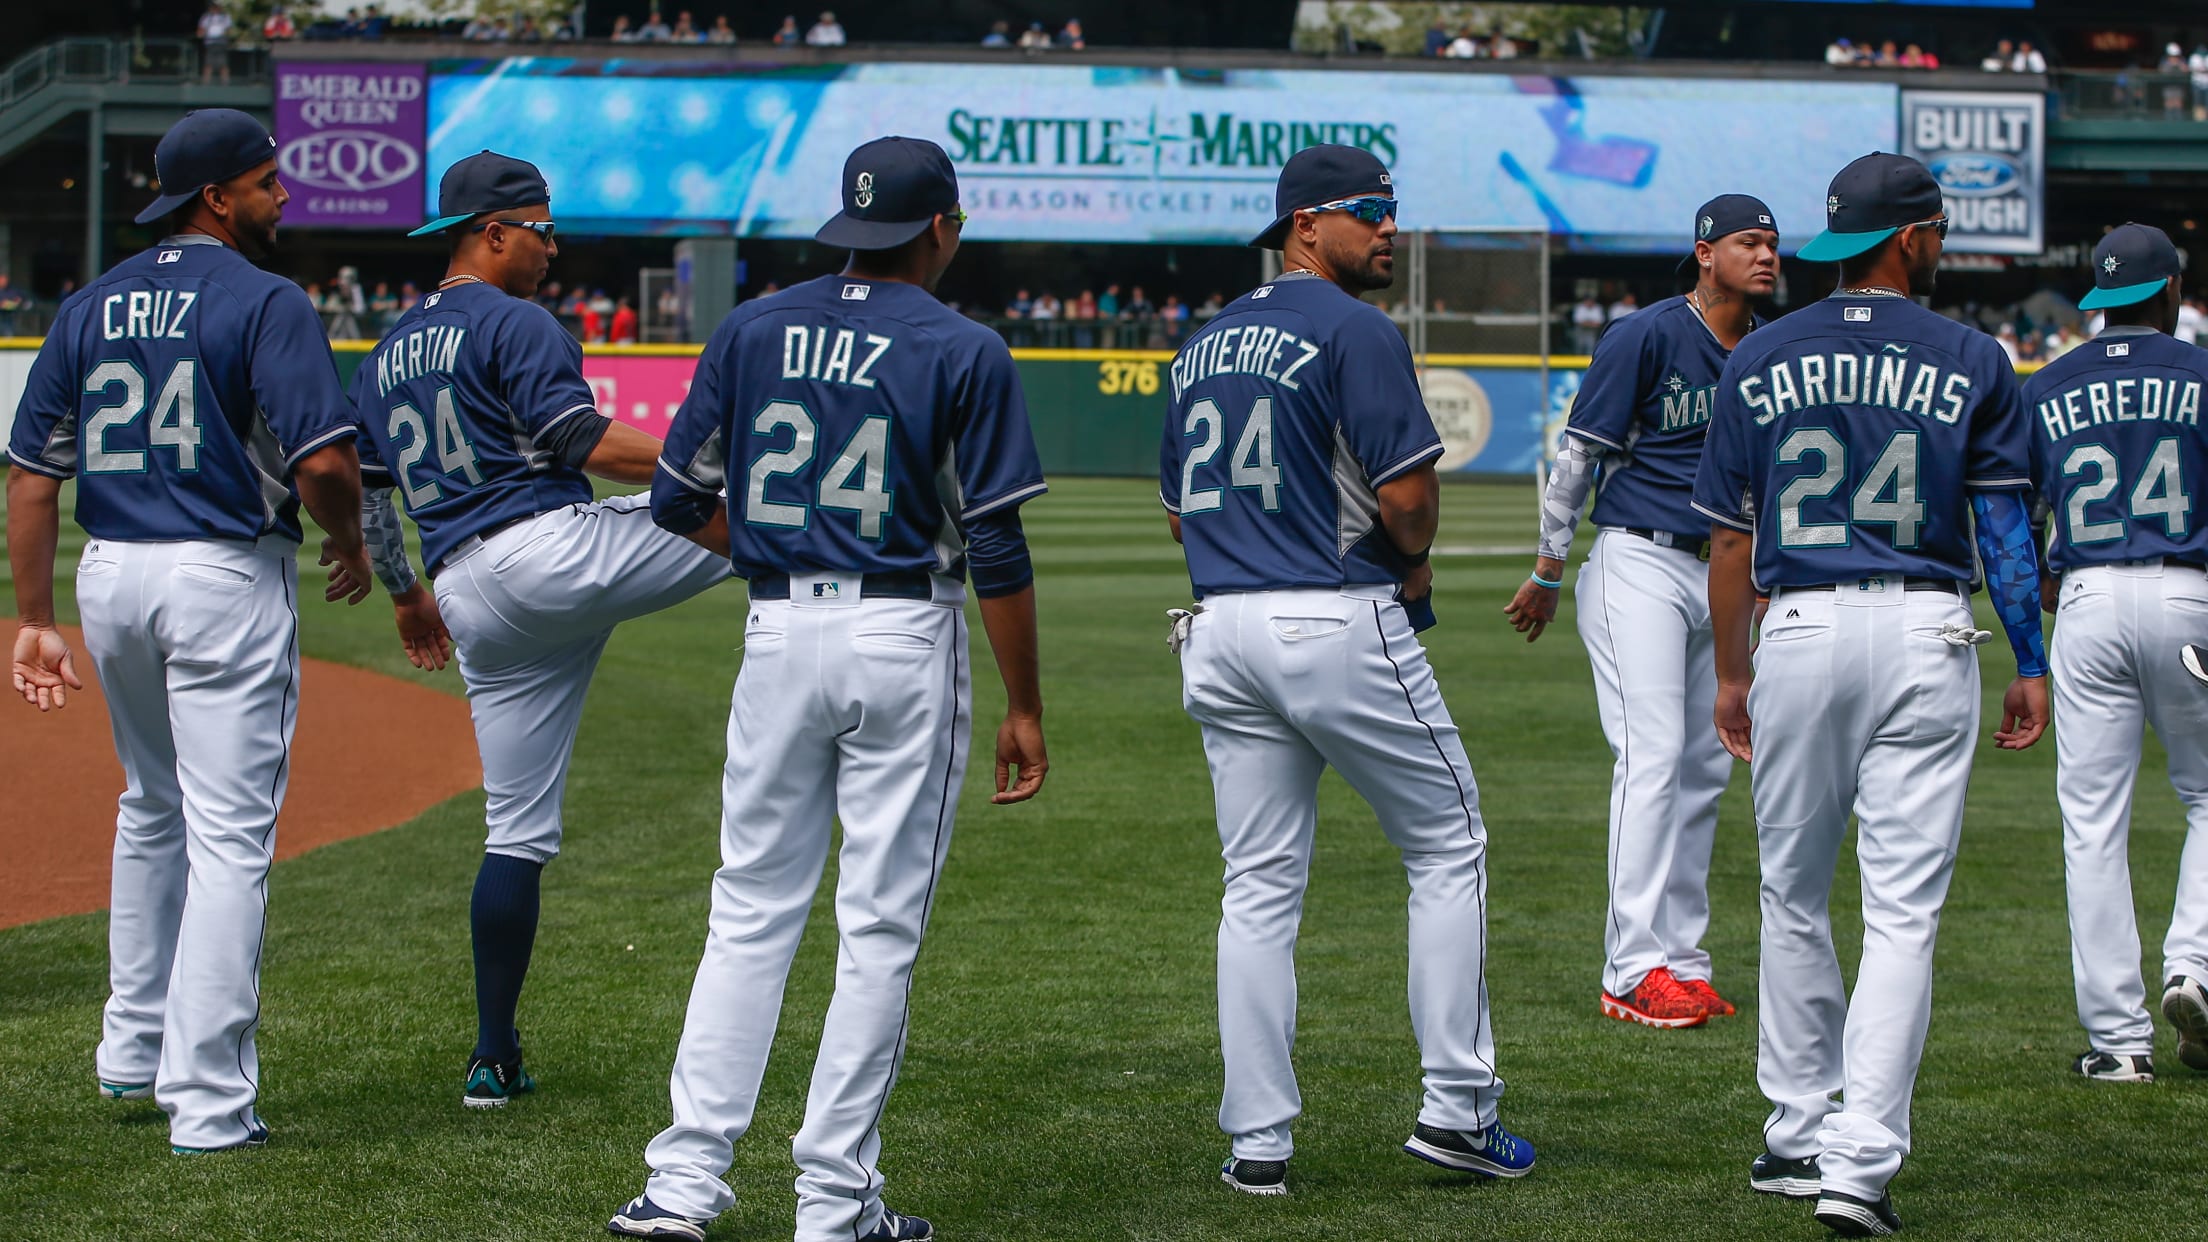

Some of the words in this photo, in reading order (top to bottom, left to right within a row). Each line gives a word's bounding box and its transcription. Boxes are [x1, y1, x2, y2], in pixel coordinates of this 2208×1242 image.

[280, 74, 422, 100] EMERALD
[300, 102, 398, 128] QUEEN
[947, 109, 1124, 166] SEATTLE
[1915, 109, 2028, 150] BUILT
[298, 137, 409, 191] EQC
[306, 198, 389, 214] CASINO
[968, 190, 1089, 210] SEASON
[1108, 190, 1212, 213] TICKET
[1231, 193, 1274, 213] HO
[1942, 199, 2028, 232] OUGH
[103, 289, 199, 341] CRUZ
[376, 324, 468, 400] MARTIN
[782, 325, 893, 390] DIAZ
[1099, 360, 1159, 396] 376
[1170, 325, 1320, 404] GUTIERREZ
[1738, 343, 1972, 426] SARDIÑAS
[83, 357, 204, 474] 24
[2037, 376, 2202, 443] HEREDIA
[388, 384, 487, 510] 24
[745, 398, 894, 542] 24
[1180, 395, 1284, 518] 24
[1776, 427, 1927, 549] 24
[2060, 435, 2192, 546] 24
